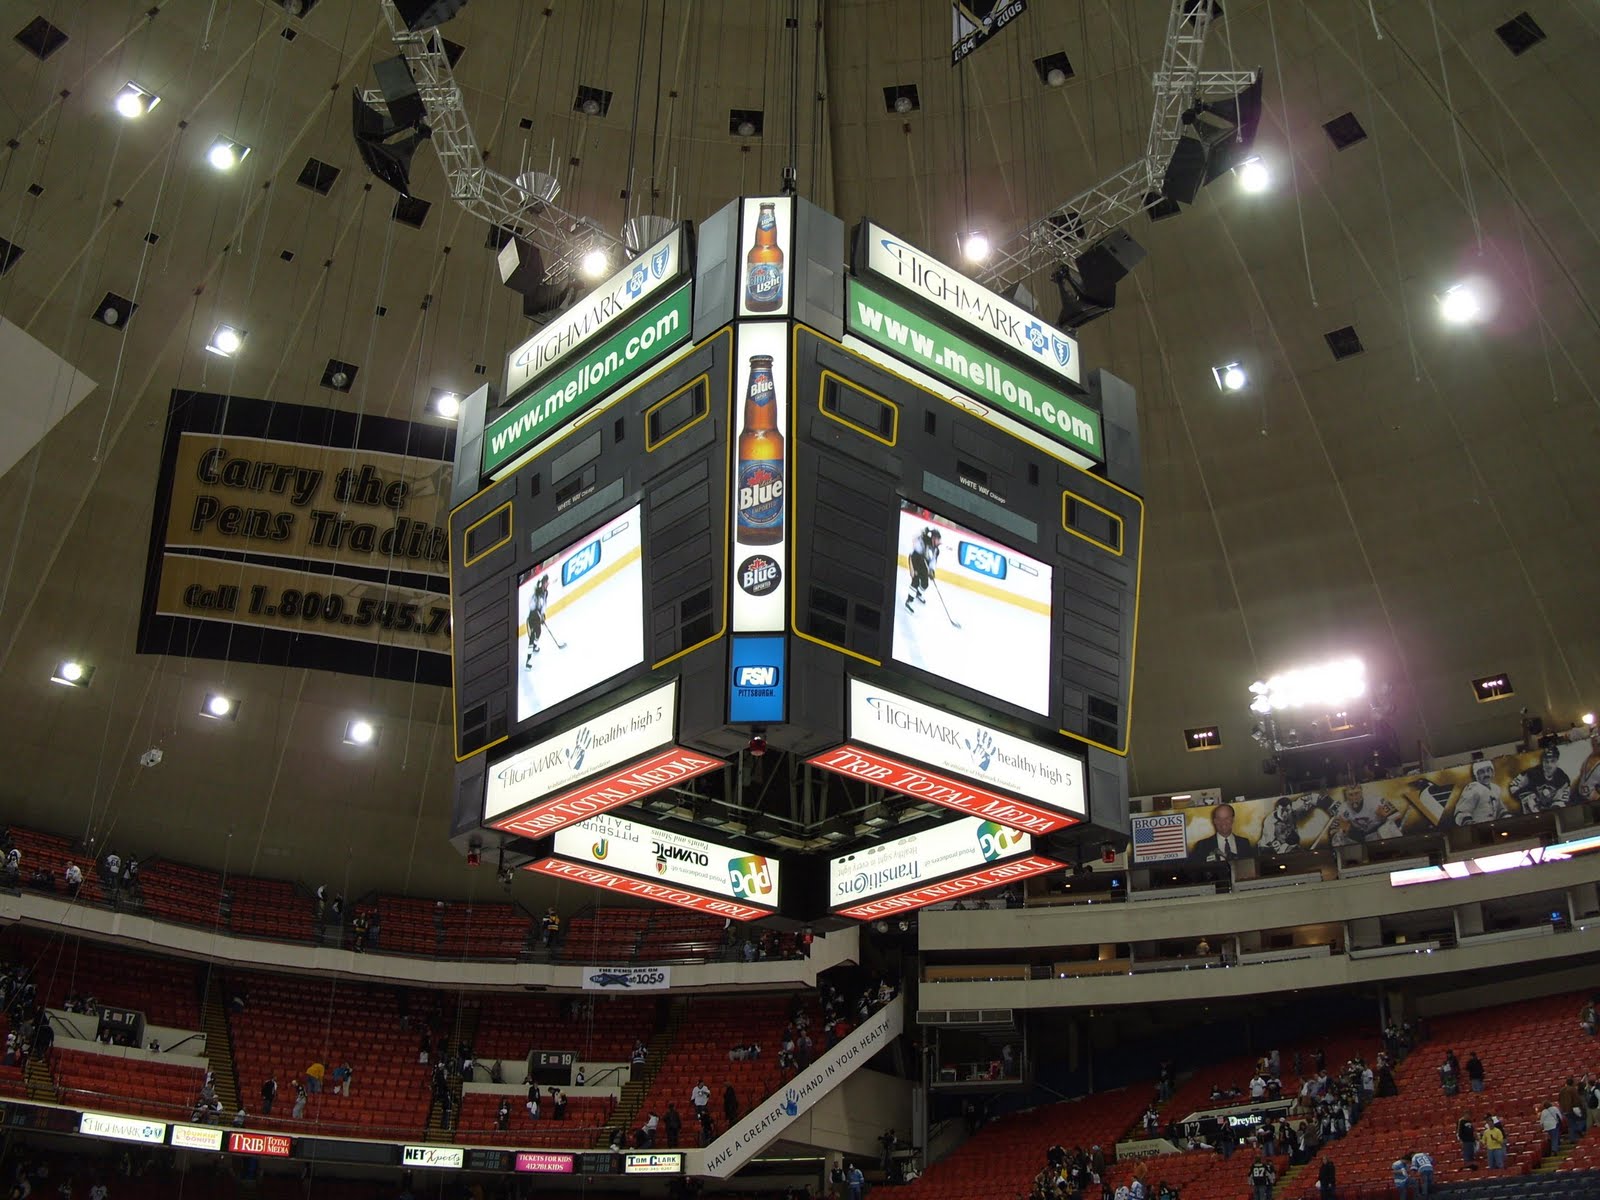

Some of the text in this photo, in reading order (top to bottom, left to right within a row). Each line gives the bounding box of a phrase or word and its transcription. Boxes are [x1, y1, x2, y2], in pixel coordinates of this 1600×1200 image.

[997, 1, 1022, 27] 2006
[756, 276, 780, 293] Light
[898, 248, 1023, 347] HIGHMARK
[524, 286, 623, 378] HIGHMARK
[491, 309, 679, 455] www.mellon.com
[857, 301, 1094, 445] www.mellon.com
[751, 381, 773, 397] Blue
[197, 448, 408, 508] Carry the
[960, 476, 977, 490] WHITE
[978, 485, 990, 495] WAY
[740, 480, 783, 510] Blue
[191, 495, 294, 541] Pens
[567, 542, 596, 582] FSN
[964, 545, 1001, 575] FSN
[743, 566, 777, 588] Blue
[183, 583, 450, 636] Call 1.800.545.7
[740, 667, 774, 686] FSN
[503, 748, 563, 788] HIGHMARK
[631, 711, 652, 734] high
[656, 706, 662, 721] 5
[877, 702, 1072, 787] HIGHMARK healthy high 5
[506, 755, 711, 836] TRIB TOTAL MEDIA
[826, 751, 1055, 832] TRIB TOTAL MEDIA
[1134, 816, 1183, 829] BROOKS
[651, 829, 672, 842] Stains
[689, 839, 709, 850] Paints
[651, 841, 709, 867] OLYMPIC
[709, 873, 726, 884] Proud
[838, 861, 921, 896] Transitions
[848, 860, 1056, 915] TRIB TOTAL MEDIA
[544, 861, 757, 919] TRIB TOTAL MEDIA
[103, 1009, 136, 1024] E 17
[541, 1054, 571, 1065] E 19
[707, 1021, 889, 1172] HAVE A GREATER HAND IN YOUR HEALTH
[88, 1118, 141, 1138] HIGHMARK
[186, 1136, 216, 1144] DONUTS
[231, 1133, 264, 1152] TRIB
[267, 1136, 290, 1146] TOTAL
[267, 1146, 289, 1154] MEDIA
[405, 1149, 426, 1160] NET
[519, 1154, 544, 1162] TICKETS
[558, 1155, 572, 1163] KIDS
[627, 1156, 676, 1166] TOM CLARK
[1119, 1149, 1160, 1158] EVOLUTION
[1253, 1167, 1265, 1178] 87
